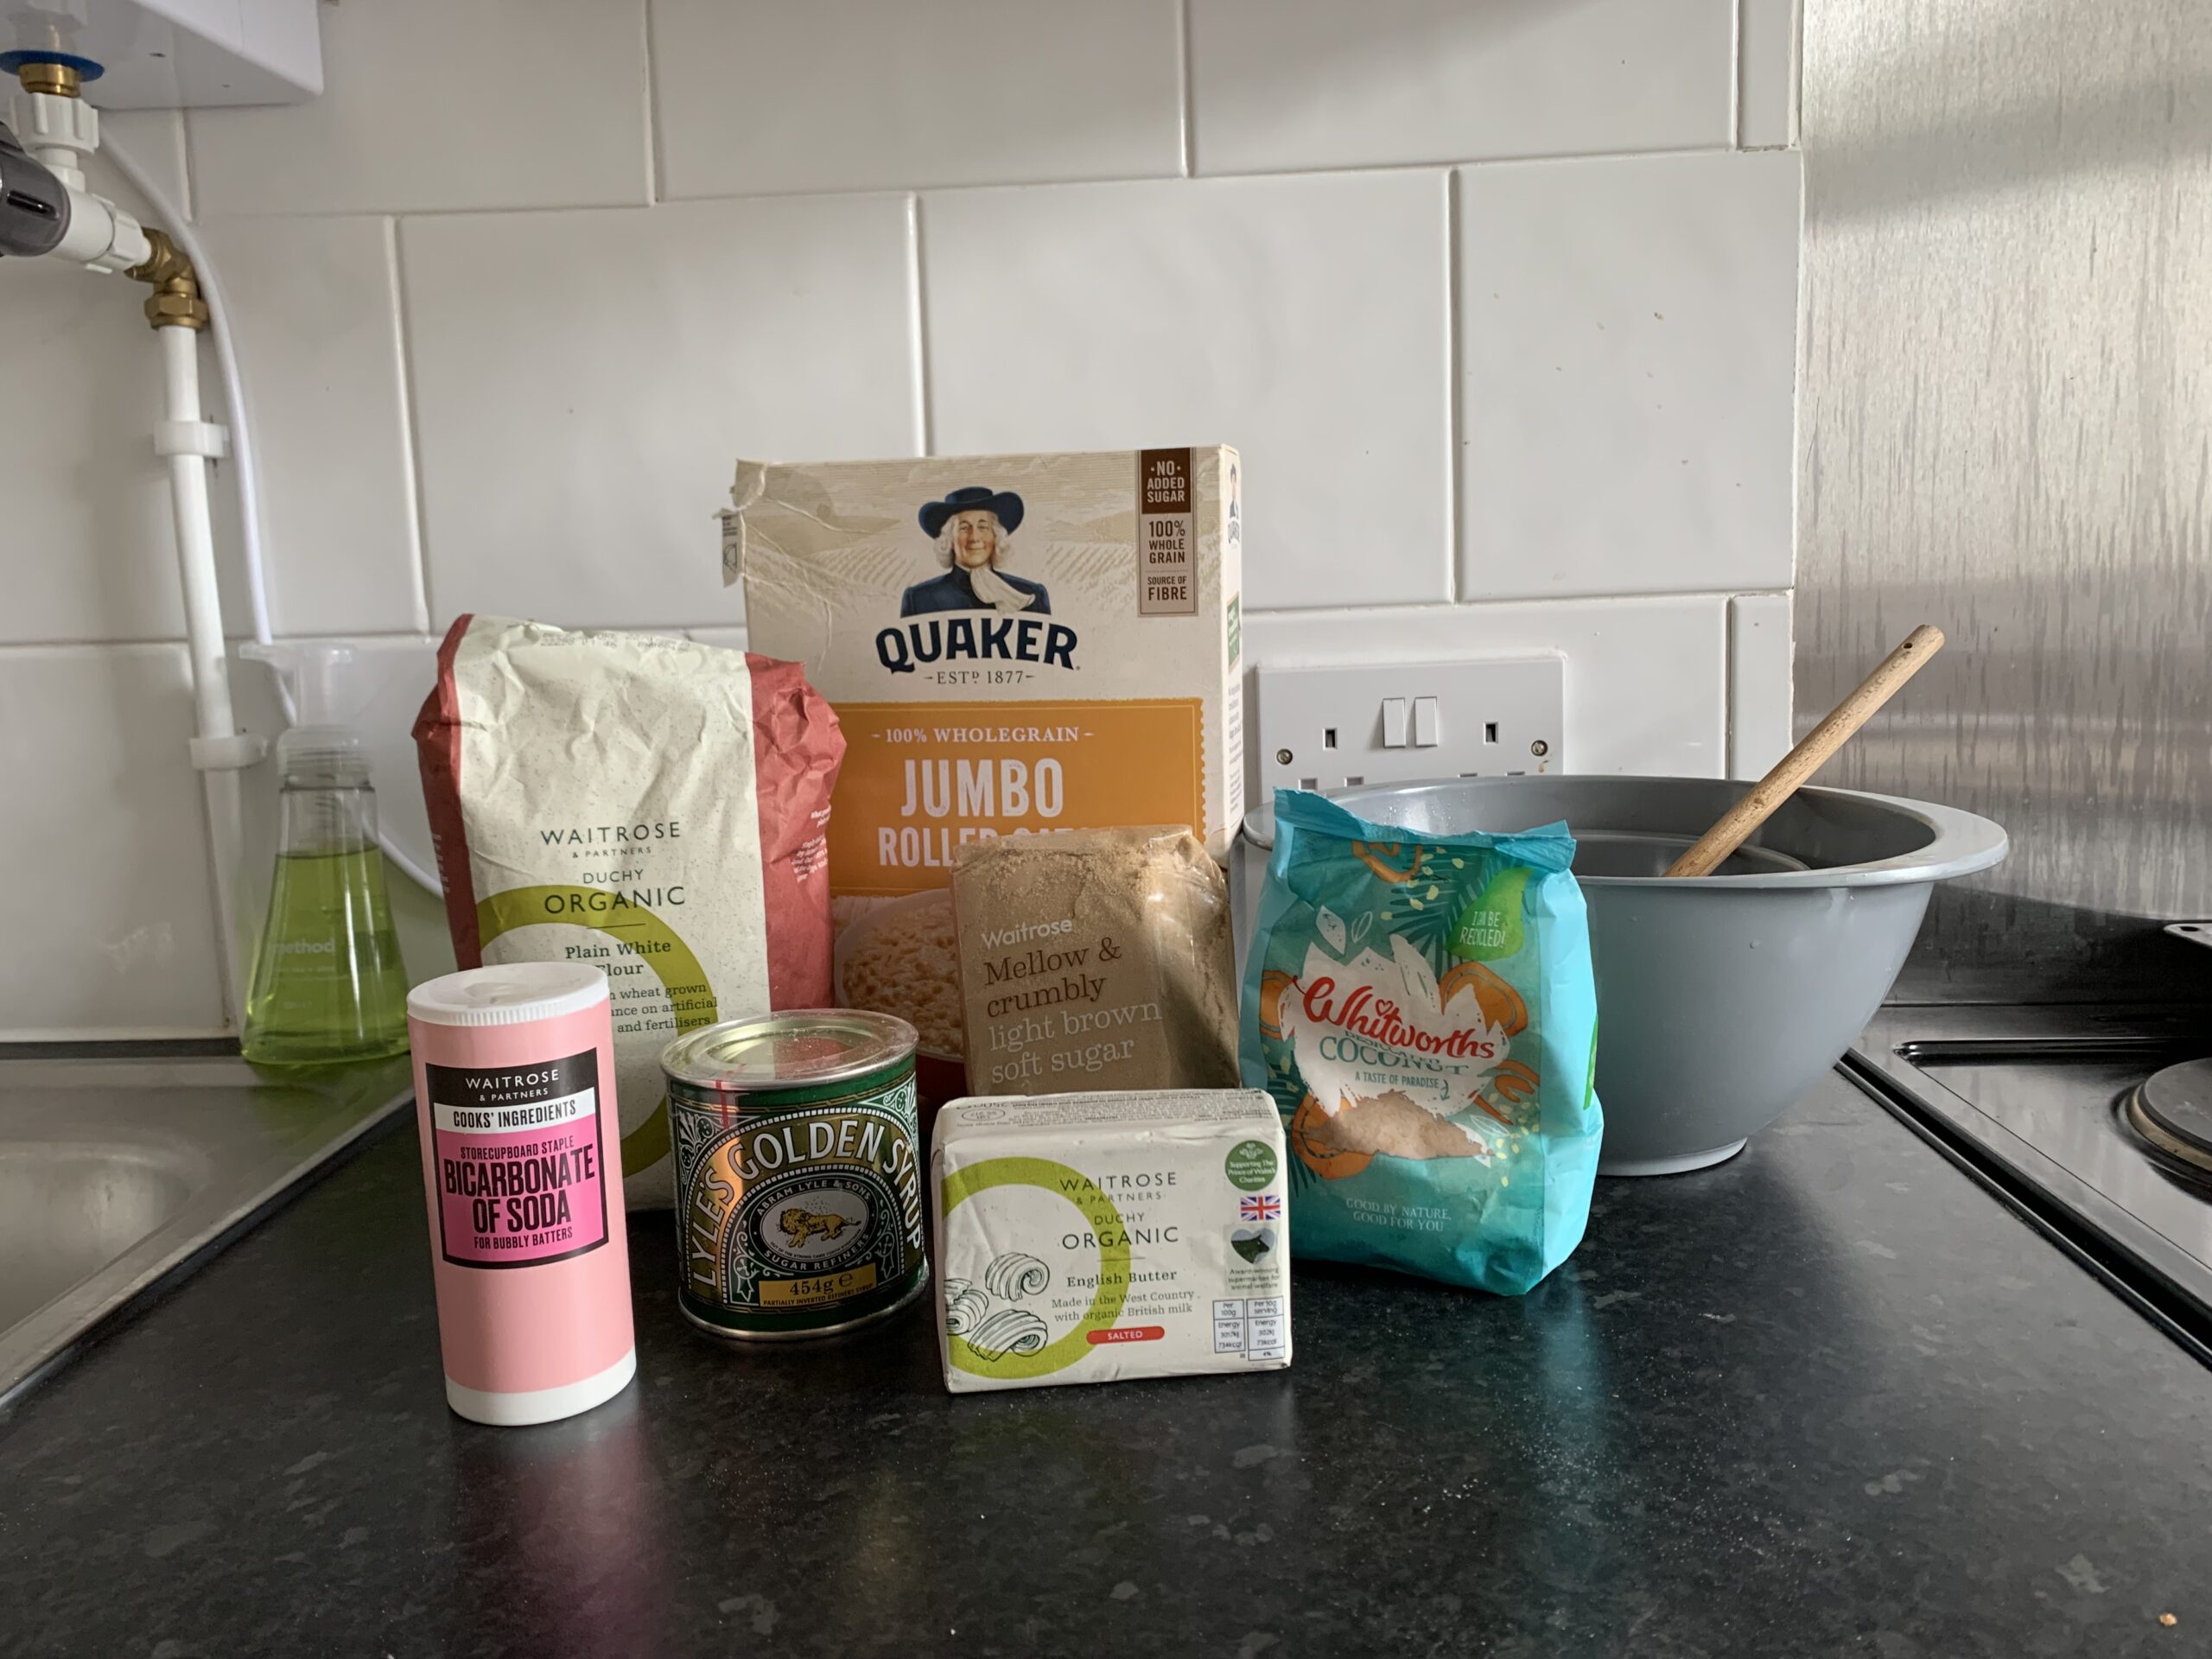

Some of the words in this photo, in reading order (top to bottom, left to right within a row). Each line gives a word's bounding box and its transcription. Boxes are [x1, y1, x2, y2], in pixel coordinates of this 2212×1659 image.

[1156, 460, 1175, 476] NO
[1147, 477, 1185, 490] ADDED
[1147, 490, 1185, 503] SUGAR
[1148, 520, 1185, 537] 100%
[1148, 538, 1185, 550] WHOLE
[1149, 551, 1185, 564] GRAIN
[1147, 575, 1175, 585] SOURCE
[1178, 575, 1186, 584] OF
[1148, 586, 1187, 601] FIBRE
[875, 618, 1077, 674] QUAKER
[987, 671, 1023, 684] 1877
[885, 728, 927, 743] 100%
[933, 726, 1079, 743] WHOLEGRAIN
[901, 758, 1064, 817] JUMBO
[540, 822, 680, 845] WAITROSE
[585, 846, 652, 857] PARTNERS
[582, 869, 644, 884] DUCHY
[544, 886, 685, 914] ORGANIC
[1488, 911, 1501, 927] BE
[981, 918, 1073, 950] Waitrose
[565, 944, 611, 959] Plain
[616, 940, 671, 956] White
[596, 963, 644, 976] lour
[983, 948, 1090, 986] Mellow
[1098, 937, 1122, 962] &
[620, 987, 661, 1000] wheat
[664, 984, 707, 997] grown
[987, 974, 1107, 1018] crumbly
[641, 1005, 658, 1014] on
[661, 996, 718, 1013] artificial
[617, 1021, 642, 1033] and
[645, 1015, 711, 1030] fertilisers
[988, 1015, 1055, 1052] light
[1060, 1001, 1162, 1035] brown
[1292, 975, 1495, 1059] Whitworths
[992, 1052, 1043, 1084] soft
[1051, 1039, 1135, 1071] sugar
[466, 1069, 560, 1090] WAITROSE
[1355, 1071, 1360, 1081] A
[1363, 1071, 1386, 1084] TASTE
[1389, 1074, 1400, 1084] OF
[1402, 1076, 1439, 1089] PARADISE
[491, 1087, 549, 1102] PARTNERS
[499, 1099, 576, 1128] INGREDIENTS
[461, 1143, 538, 1160] STORECUPBOARD
[541, 1135, 574, 1154] STAPLE
[443, 1143, 595, 1197] BICARBONATE
[1059, 1172, 1177, 1192] WAITROSE
[691, 1168, 734, 1287] LYLE'S
[728, 1120, 885, 1180] GOLDEN
[882, 1138, 921, 1249] SYRUP
[757, 1187, 793, 1216] ABRAM
[798, 1179, 828, 1192] LYLE
[845, 1180, 871, 1200] SONS
[1090, 1192, 1161, 1204] PARTNERS
[1346, 1198, 1380, 1212] GOOD
[472, 1198, 501, 1234] OF
[506, 1189, 572, 1233] SODA
[1094, 1212, 1145, 1225] DUCHY
[1353, 1211, 1387, 1225] GOOD
[1390, 1216, 1414, 1230] FOR
[1418, 1219, 1444, 1232] YOU
[474, 1236, 491, 1249] FOR
[493, 1235, 530, 1249] BUBBLY
[532, 1227, 573, 1245] BATTERS
[1062, 1227, 1179, 1249] ORGANIC
[764, 1249, 807, 1270] SUGAR
[814, 1233, 869, 1269] REFINERS
[790, 1279, 834, 1295] 454g
[1067, 1273, 1122, 1289] English
[1128, 1270, 1178, 1283] Butter
[1052, 1297, 1082, 1309] Made
[1084, 1297, 1096, 1306] in
[1098, 1295, 1116, 1305] the
[1119, 1293, 1147, 1304] West
[1150, 1290, 1195, 1301] Country
[1054, 1311, 1080, 1323] with
[1083, 1308, 1124, 1322] organic
[1128, 1305, 1165, 1317] British
[1168, 1303, 1192, 1313] milk
[1107, 1331, 1143, 1341] SALTED
